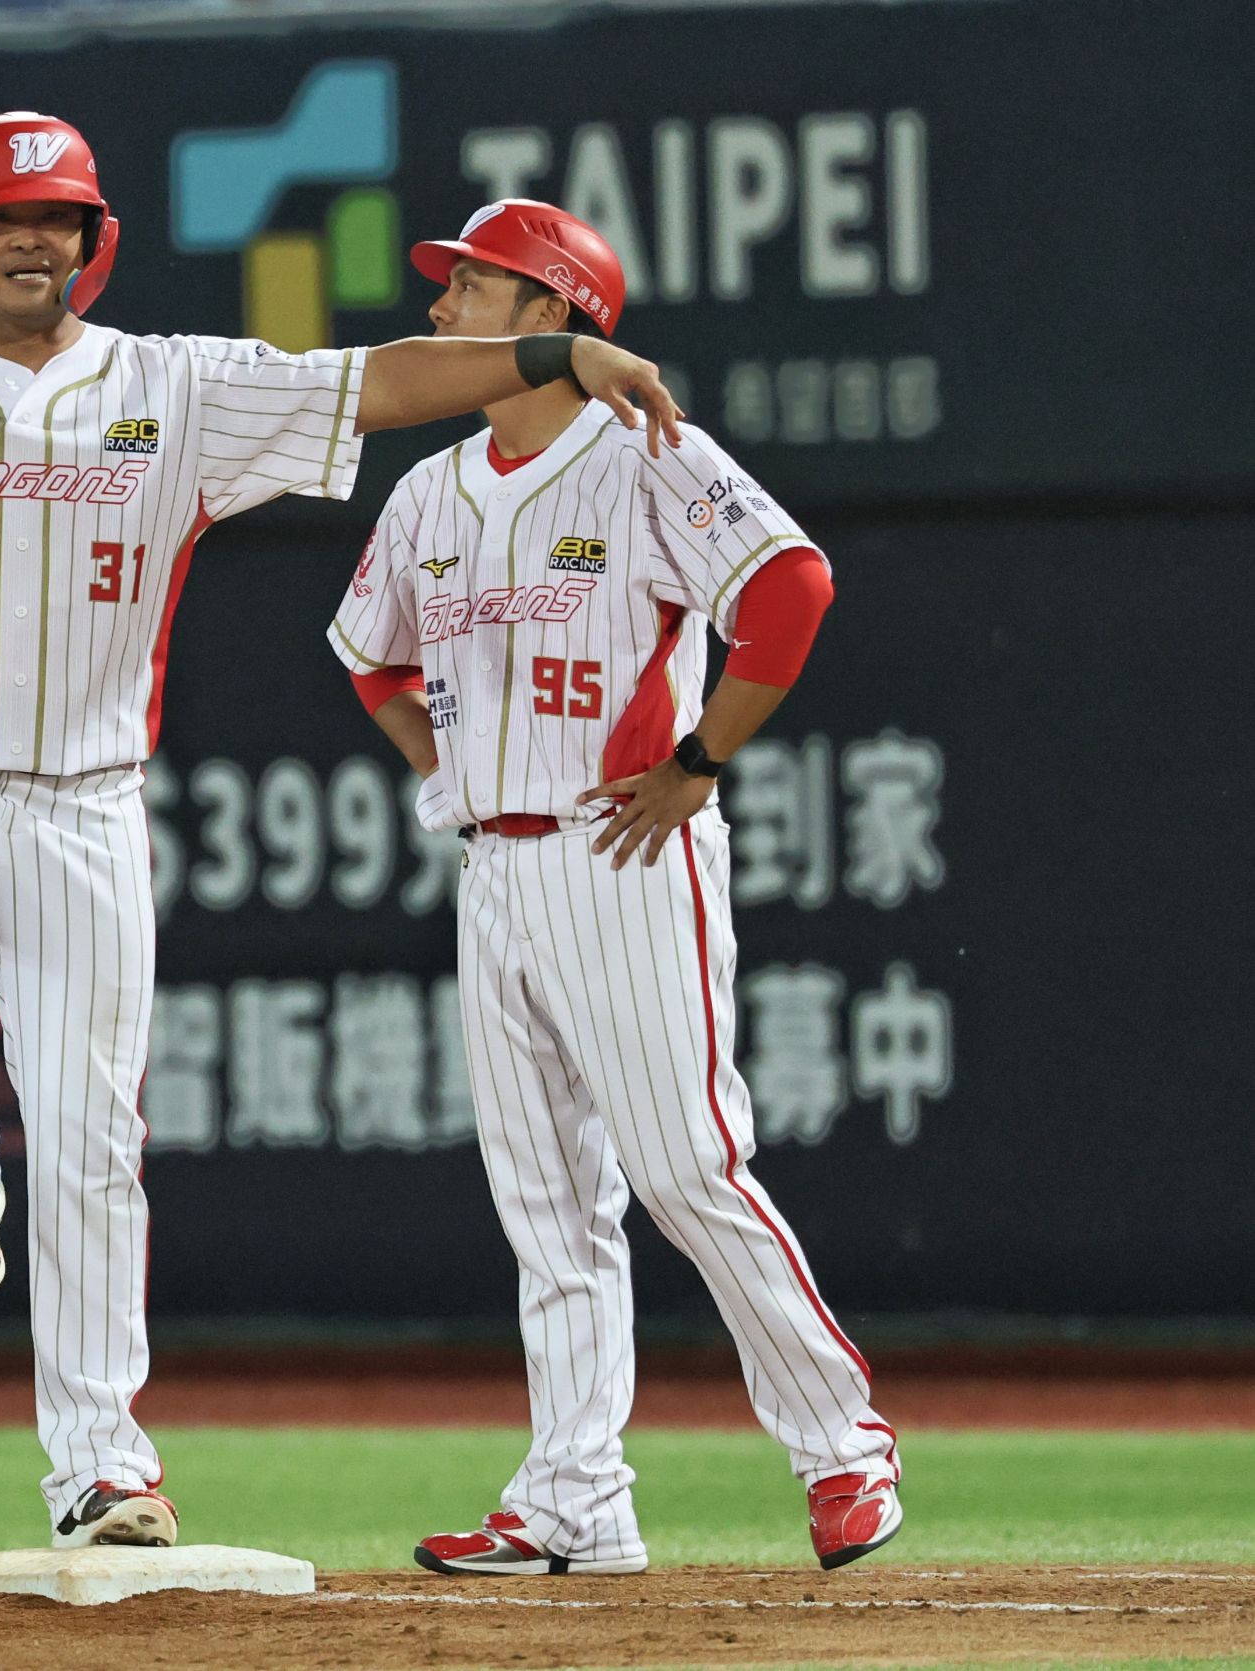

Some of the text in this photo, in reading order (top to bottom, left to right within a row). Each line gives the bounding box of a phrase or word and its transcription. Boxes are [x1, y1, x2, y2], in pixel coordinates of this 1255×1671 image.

[9, 132, 71, 174] W
[460, 110, 930, 304] TAIPEI
[107, 419, 159, 439] BC
[105, 437, 157, 452] RACING
[706, 476, 763, 504] BAN
[552, 537, 606, 559] BC
[89, 541, 145, 604] 31
[549, 556, 605, 573] RACING
[532, 656, 603, 719] 95
